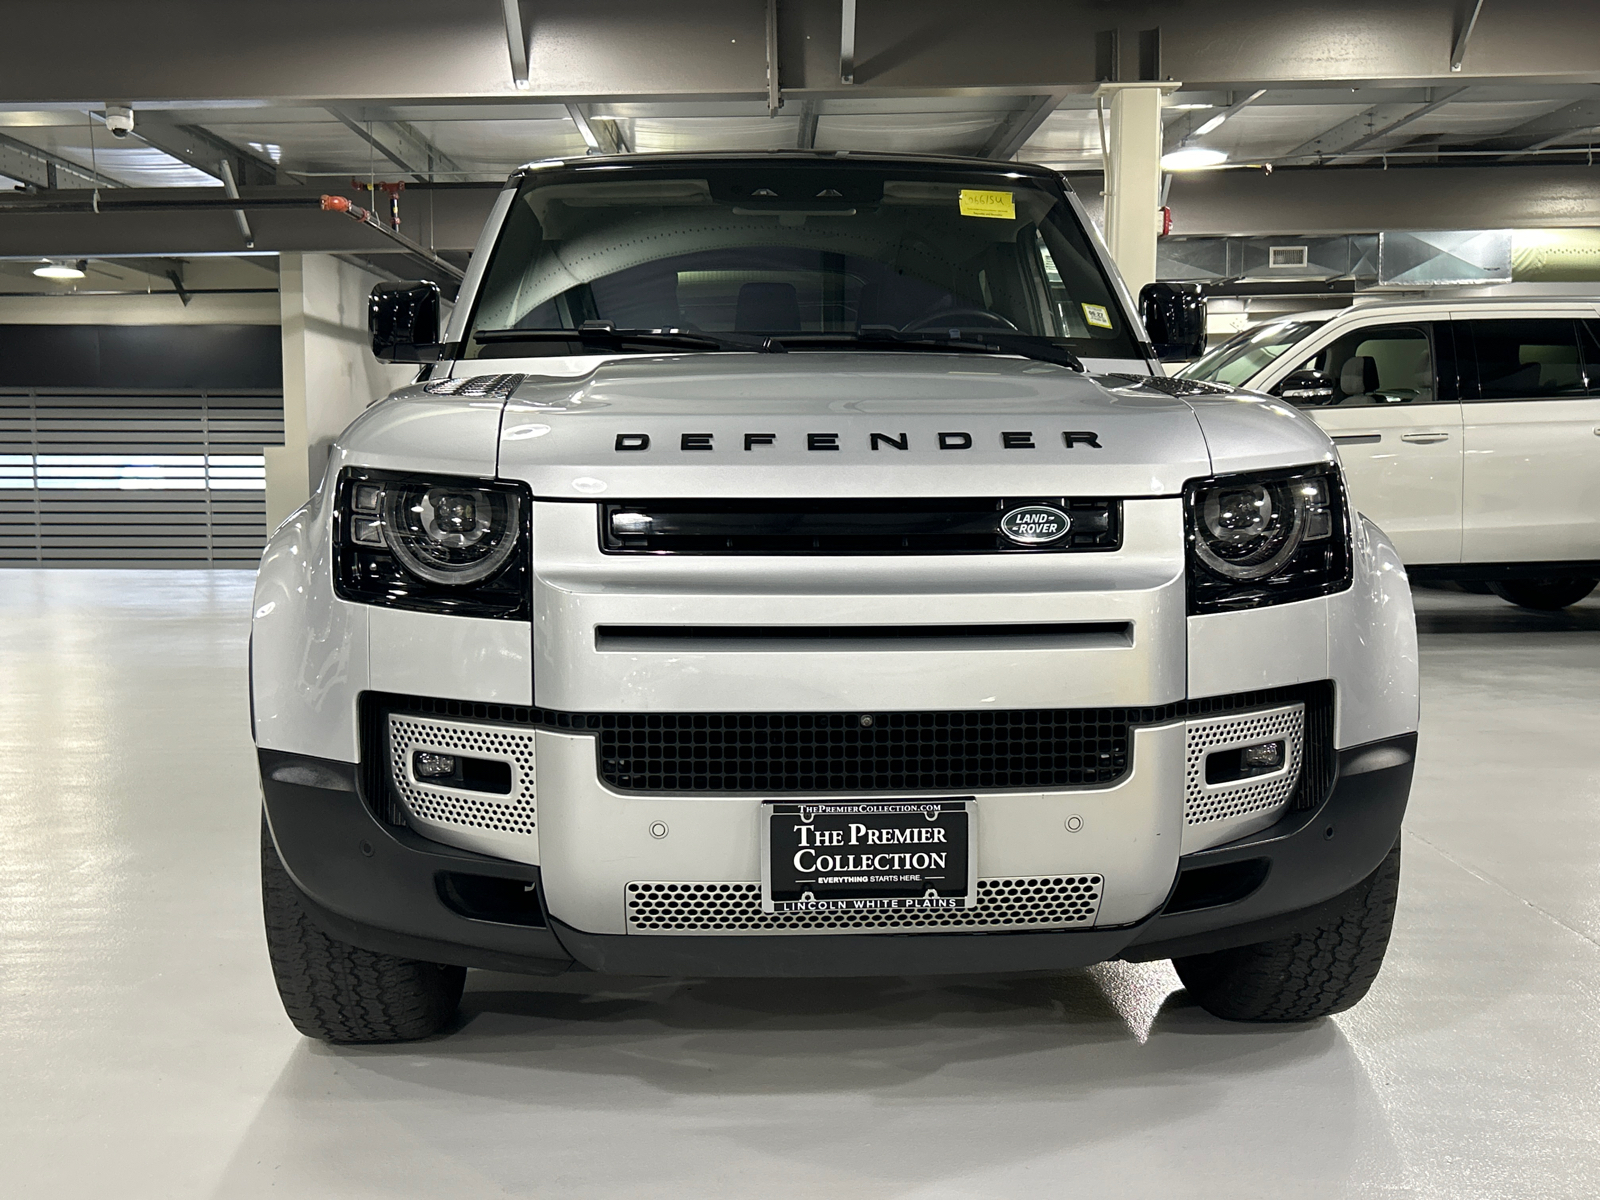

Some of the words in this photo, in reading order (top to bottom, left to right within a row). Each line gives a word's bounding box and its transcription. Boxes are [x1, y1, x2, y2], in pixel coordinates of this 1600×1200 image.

[614, 431, 1103, 451] DEFENDER
[798, 804, 941, 813] THEPREMIERCOLLECTION.COM
[793, 824, 844, 847] THE
[848, 823, 947, 845] PREMIER
[793, 849, 947, 873] COLLECTION
[818, 875, 869, 884] EVERYTHING
[869, 875, 898, 883] STARTS
[783, 901, 846, 911] LINCOLN
[853, 899, 898, 909] WHITE
[906, 898, 956, 908] PLAINS
